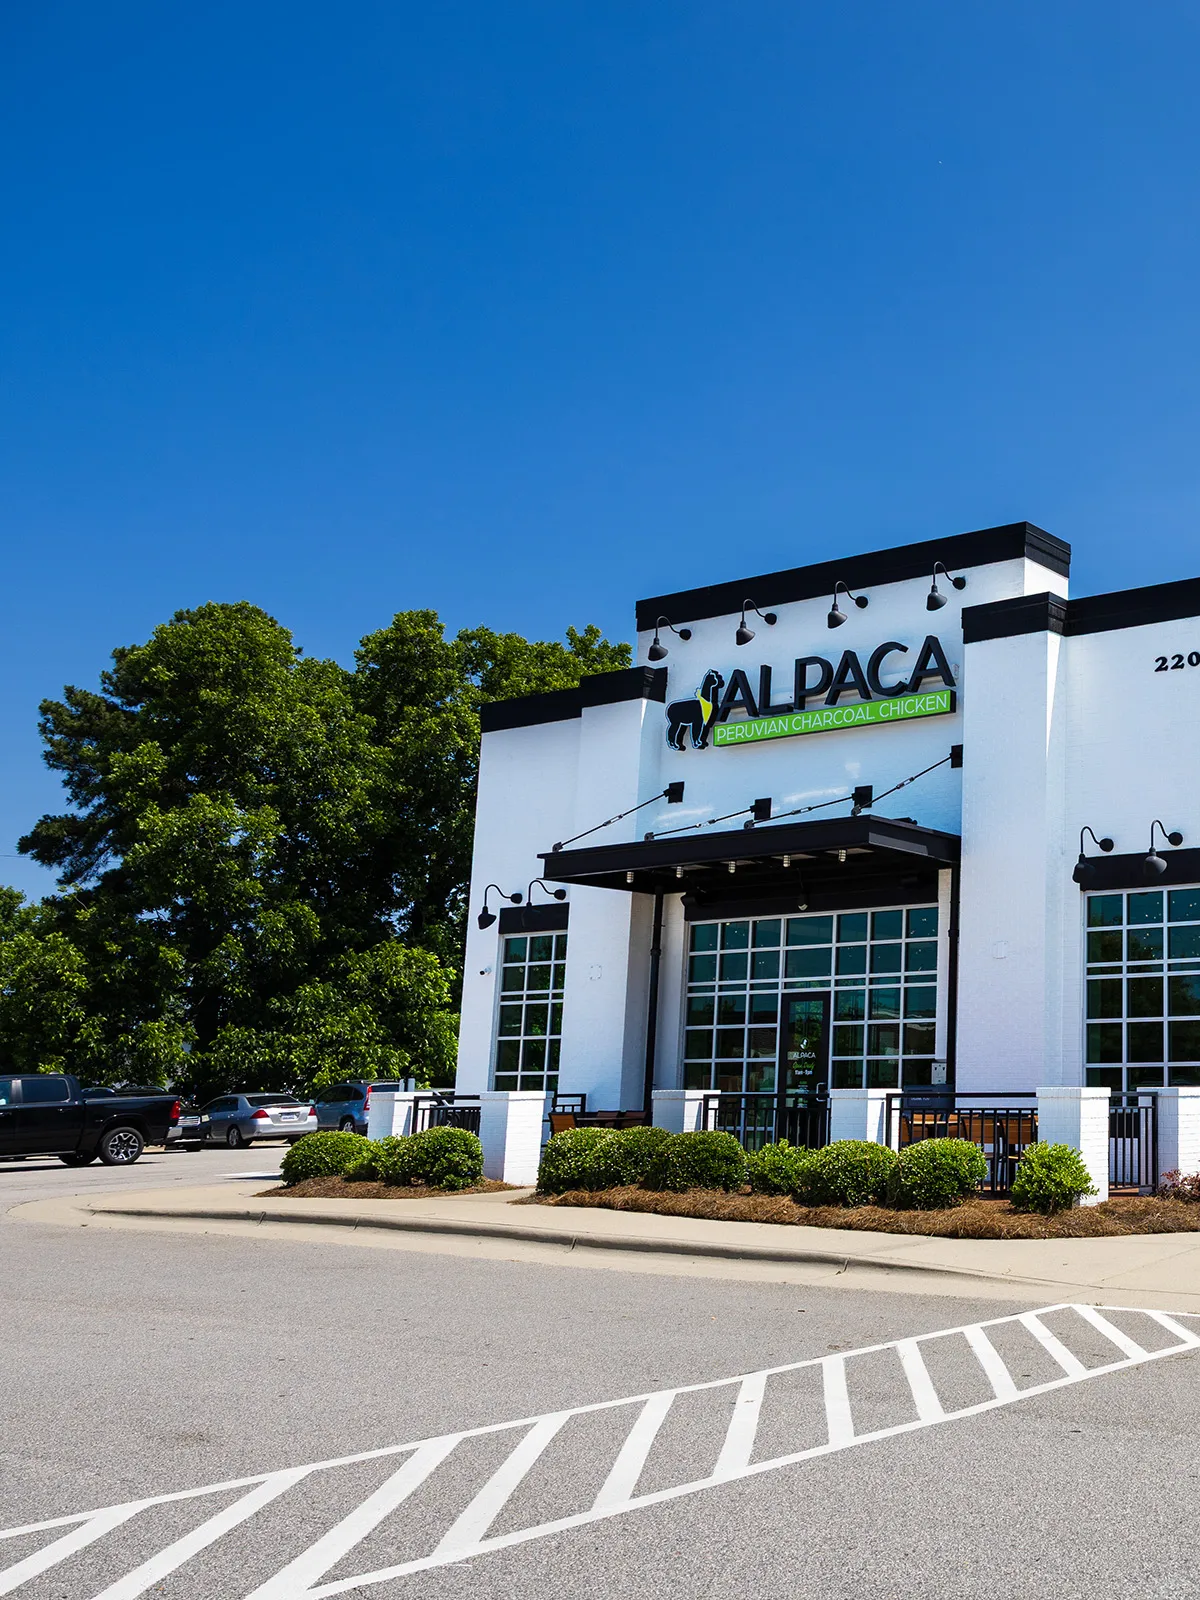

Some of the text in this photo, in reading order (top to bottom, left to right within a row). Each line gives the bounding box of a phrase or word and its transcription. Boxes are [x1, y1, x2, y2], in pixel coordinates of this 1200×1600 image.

[717, 634, 957, 722] ALPACA
[716, 693, 948, 743] PERUVIAN CHARCOAL CHICKEN
